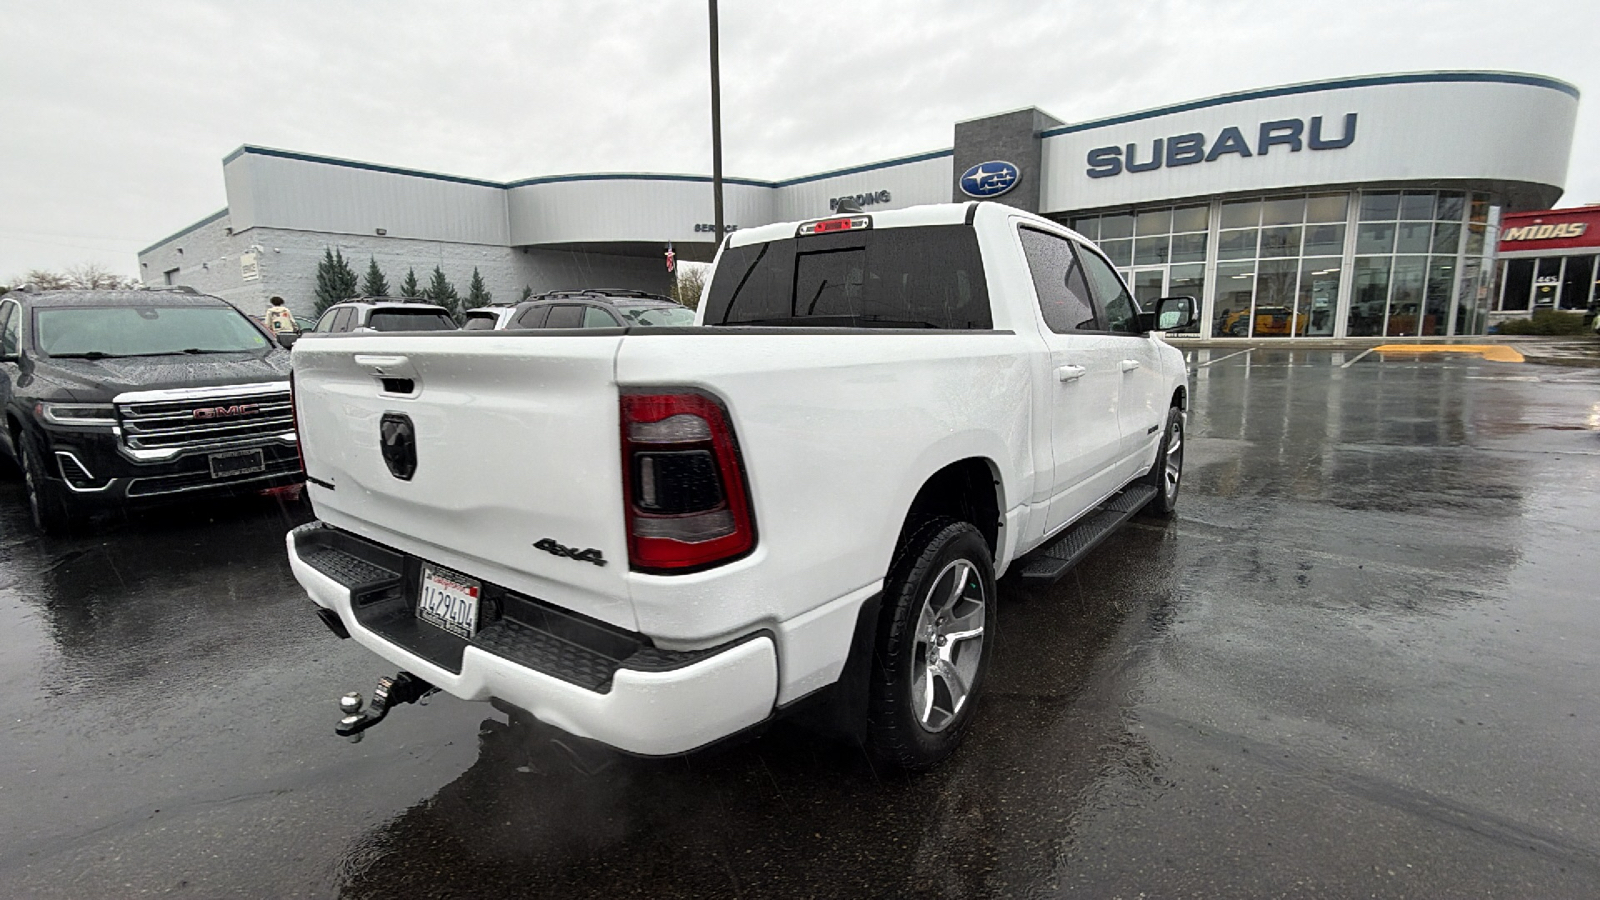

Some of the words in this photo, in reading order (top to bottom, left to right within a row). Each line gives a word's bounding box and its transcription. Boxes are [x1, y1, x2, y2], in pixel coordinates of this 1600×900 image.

[1086, 112, 1358, 179] SUBARU
[829, 189, 891, 211] RDING
[694, 223, 738, 233] SERCE
[1501, 222, 1588, 241] MIDAS
[193, 403, 259, 419] GMC
